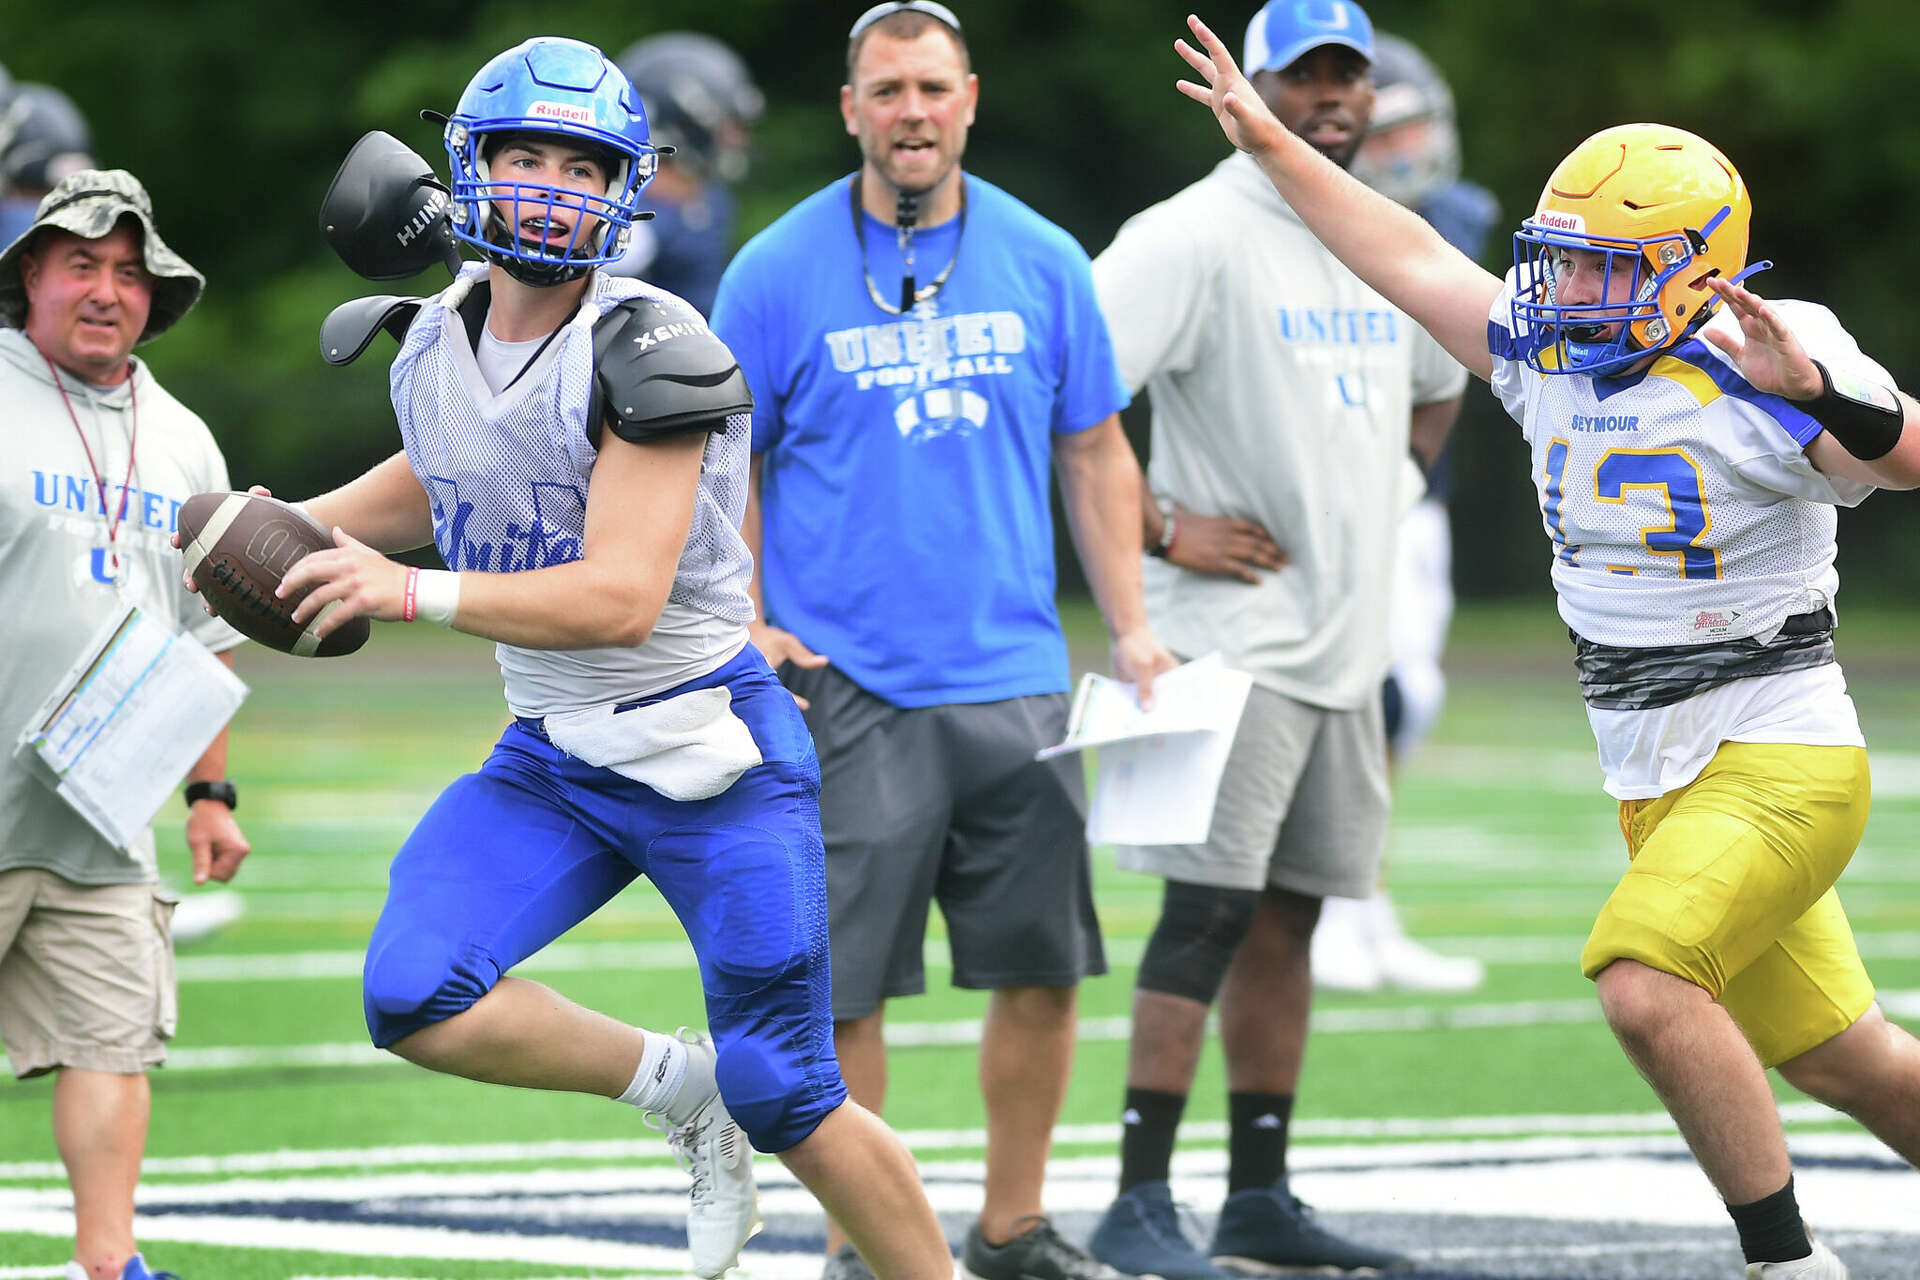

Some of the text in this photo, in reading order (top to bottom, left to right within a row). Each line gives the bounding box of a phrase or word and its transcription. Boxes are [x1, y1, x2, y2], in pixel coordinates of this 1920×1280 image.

[536, 104, 589, 121] Riddell
[396, 189, 446, 248] ENITH
[1539, 213, 1577, 231] Riddell
[824, 311, 1025, 373] UNITED
[855, 354, 1014, 391] FOOTBALL
[1571, 414, 1640, 433] SEYMOUR
